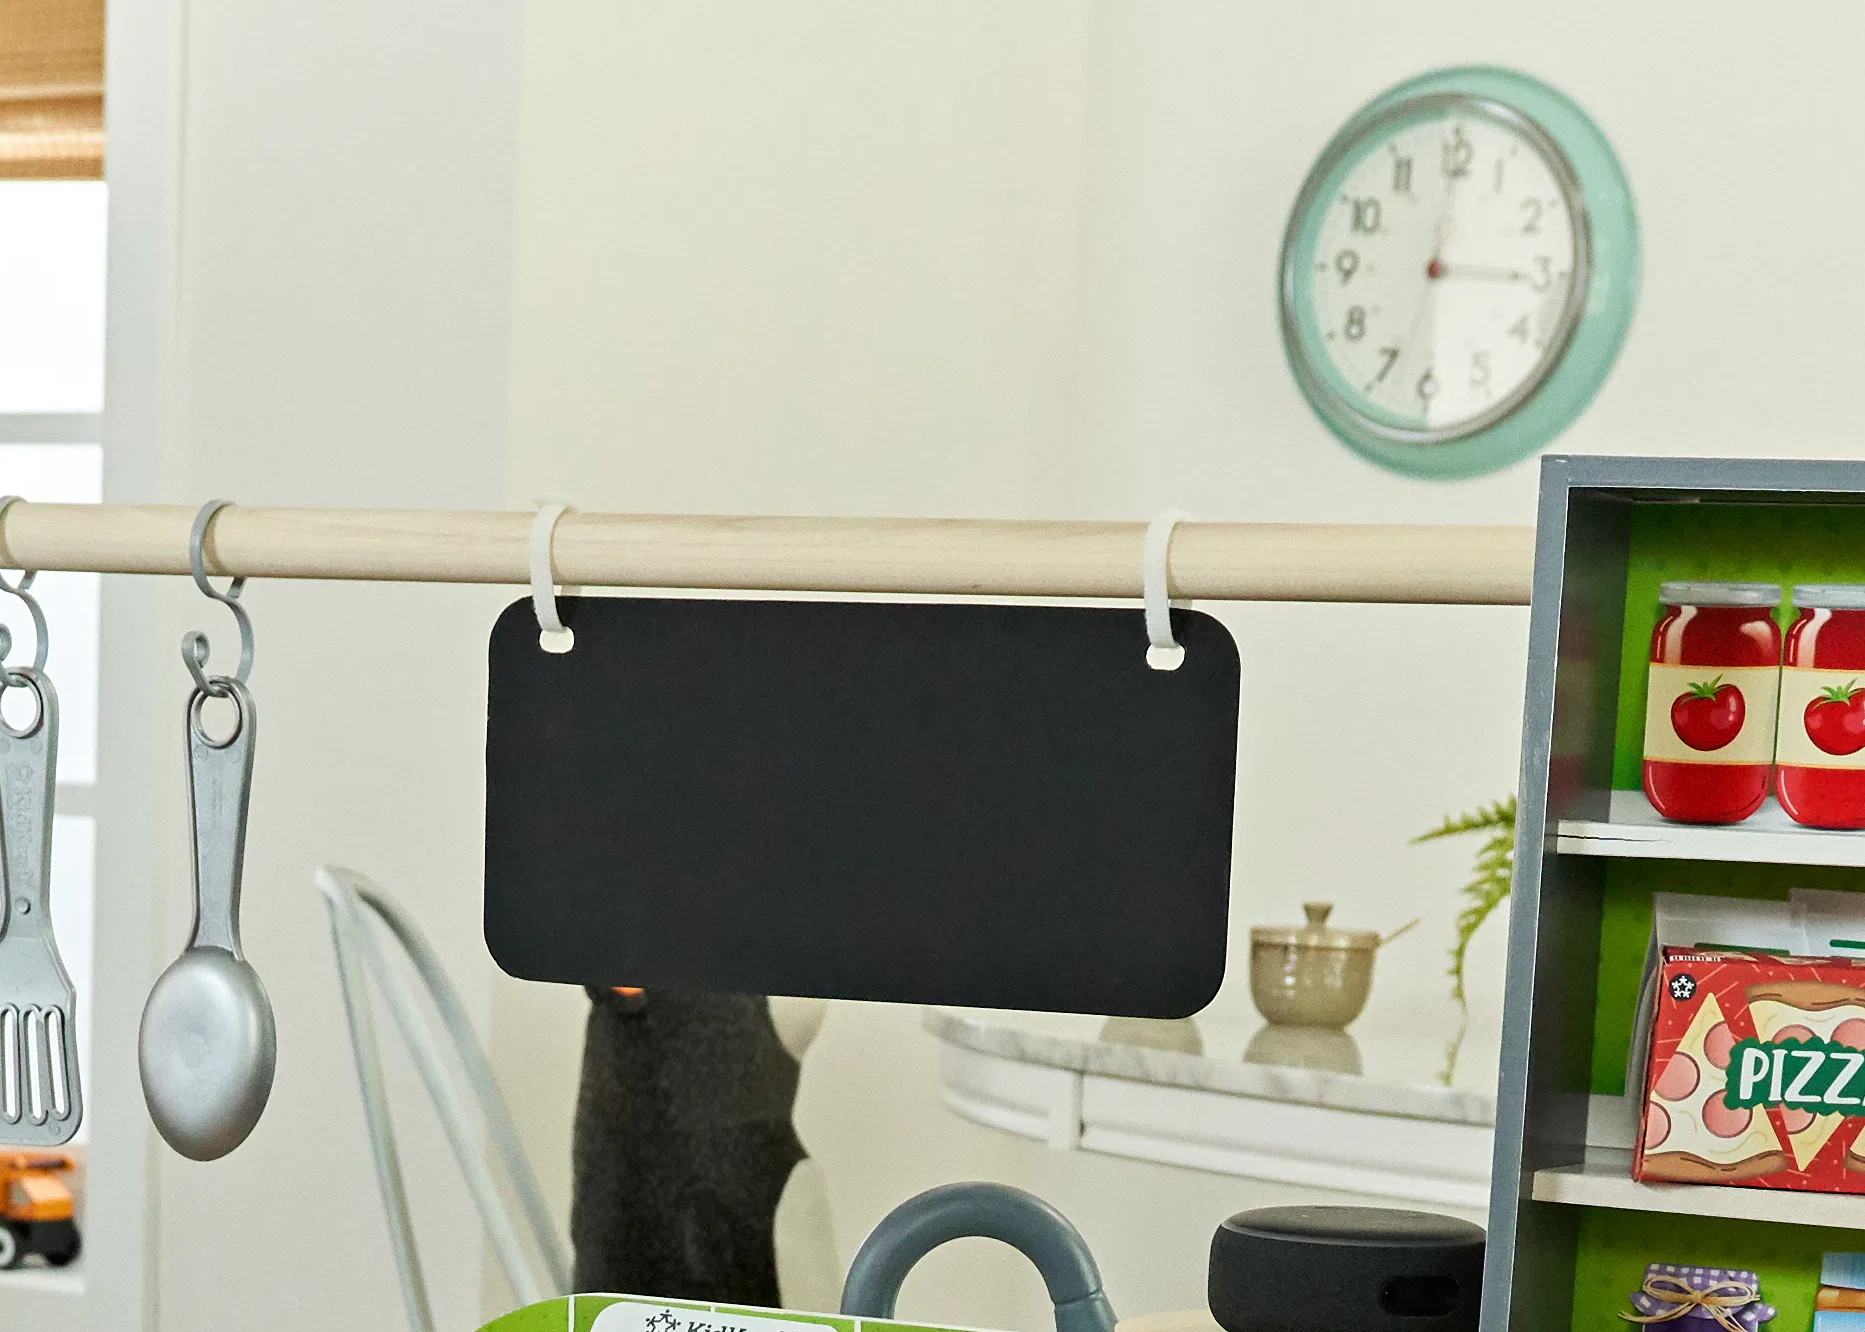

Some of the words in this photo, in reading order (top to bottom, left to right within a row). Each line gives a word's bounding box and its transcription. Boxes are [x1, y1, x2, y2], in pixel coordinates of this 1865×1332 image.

[1441, 136, 1474, 179] 12
[1351, 198, 1382, 235] 10
[1520, 197, 1542, 234] 2
[1335, 248, 1360, 286] 9
[1531, 255, 1553, 292] 3
[1344, 304, 1367, 343] 8
[1506, 312, 1530, 344] 4
[1377, 347, 1400, 383] 7
[1469, 351, 1492, 387] 5
[1416, 367, 1440, 401] 6
